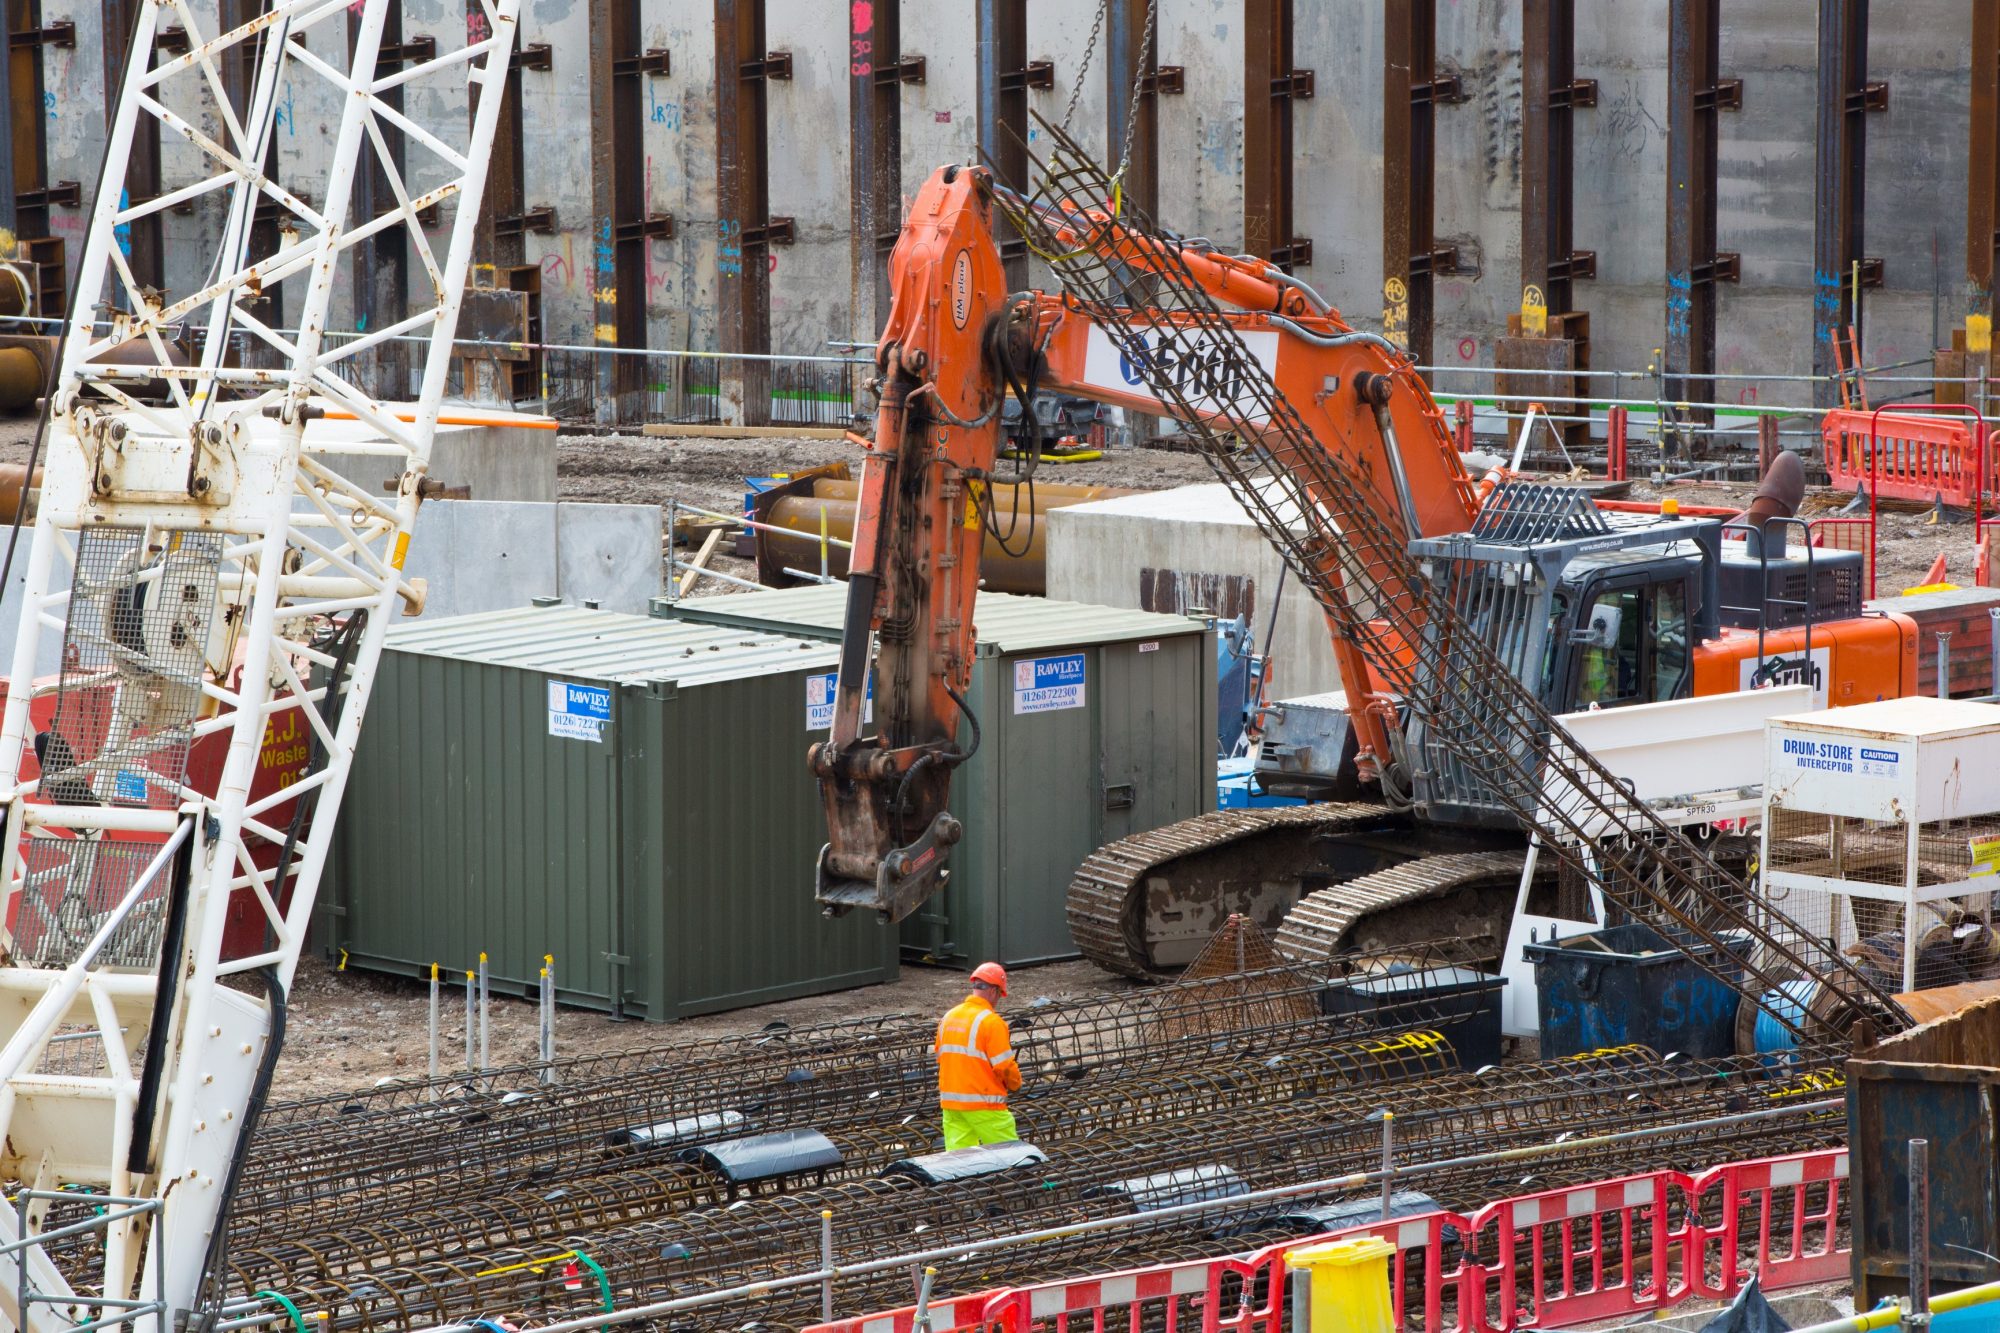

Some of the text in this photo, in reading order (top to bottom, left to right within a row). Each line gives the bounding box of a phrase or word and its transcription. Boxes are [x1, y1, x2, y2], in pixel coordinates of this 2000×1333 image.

[1153, 336, 1243, 400] Erith
[1036, 660, 1082, 677] RAWLEY
[569, 689, 609, 707] RAWLEY
[1022, 687, 1077, 702] 01268 722300
[1022, 698, 1076, 711] www.rawley.co.uk
[261, 745, 307, 769] Waste
[1783, 739, 1853, 761] DRUM-STORE
[1862, 750, 1897, 761] CAUTION!
[1797, 757, 1853, 773] INTERCEPTOR
[1686, 805, 1716, 817] SPTR30
